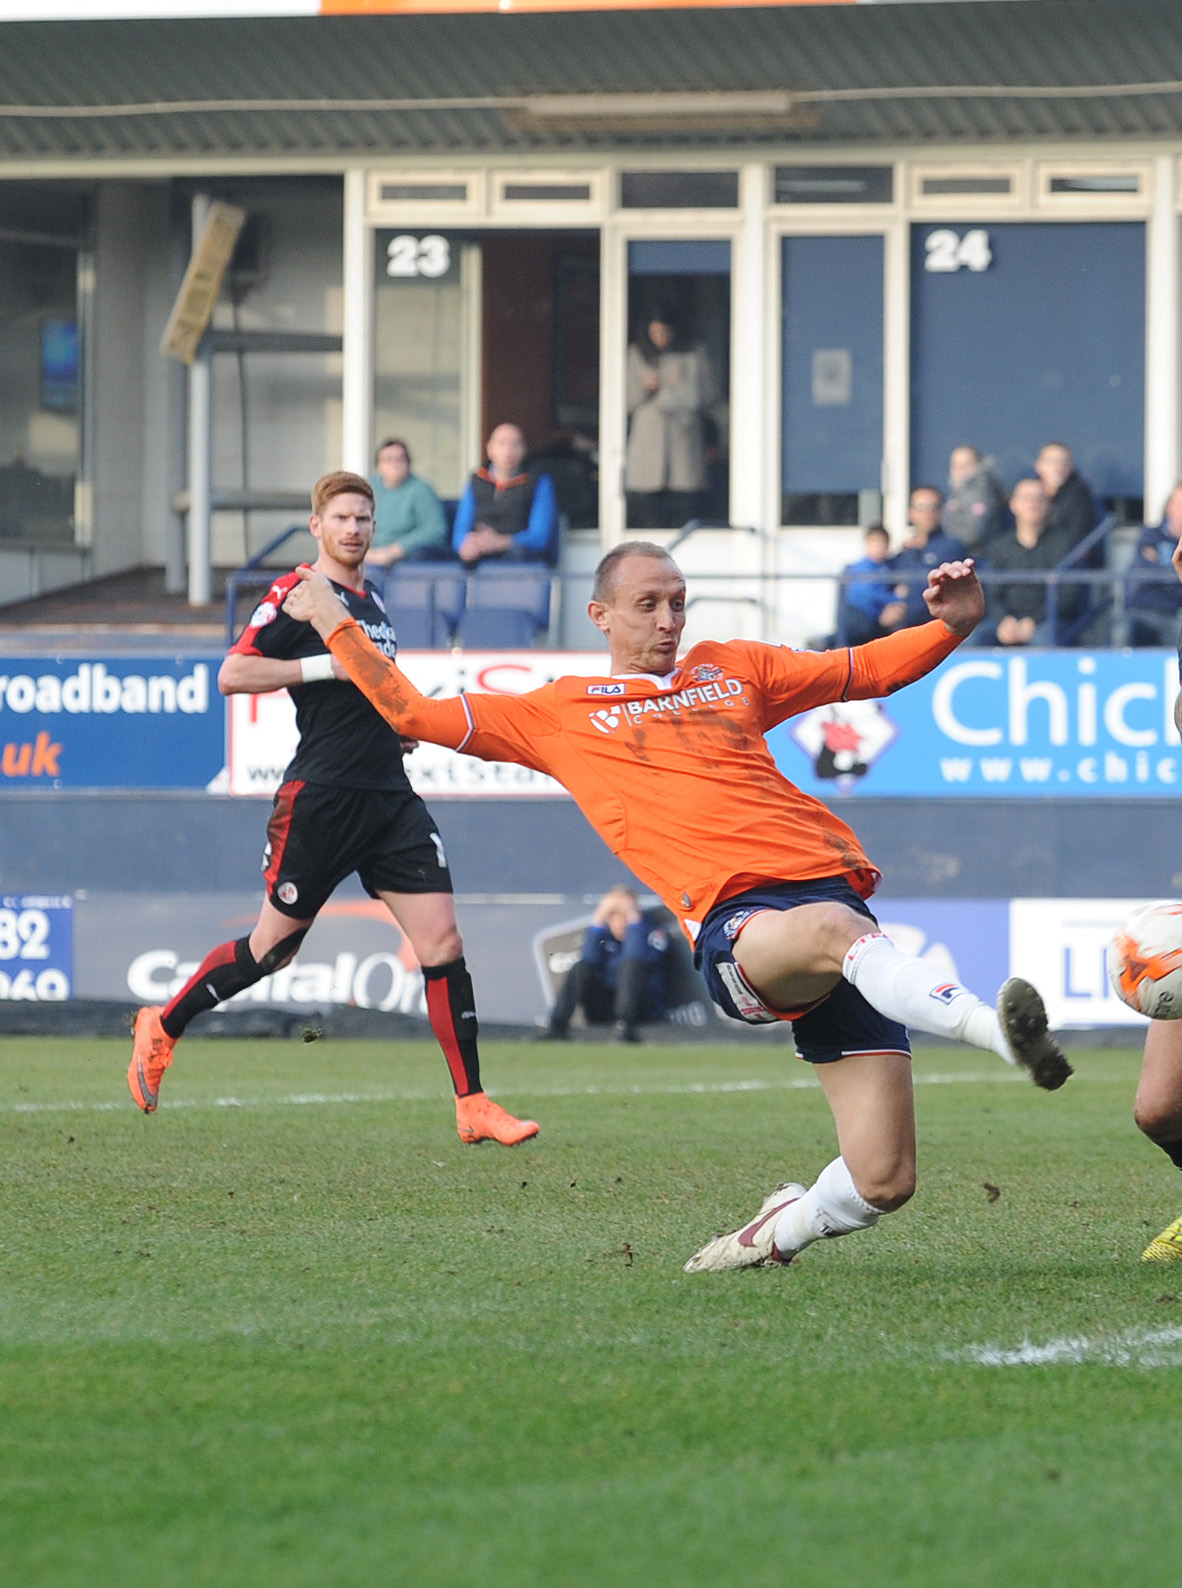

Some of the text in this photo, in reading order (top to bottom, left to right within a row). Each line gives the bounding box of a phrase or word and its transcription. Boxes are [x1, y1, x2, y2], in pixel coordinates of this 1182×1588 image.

[387, 234, 450, 278] 23
[924, 229, 992, 272] 24
[591, 685, 622, 695] FILA
[626, 678, 744, 716] BARNFIELD
[127, 949, 429, 1013] CatalOn
